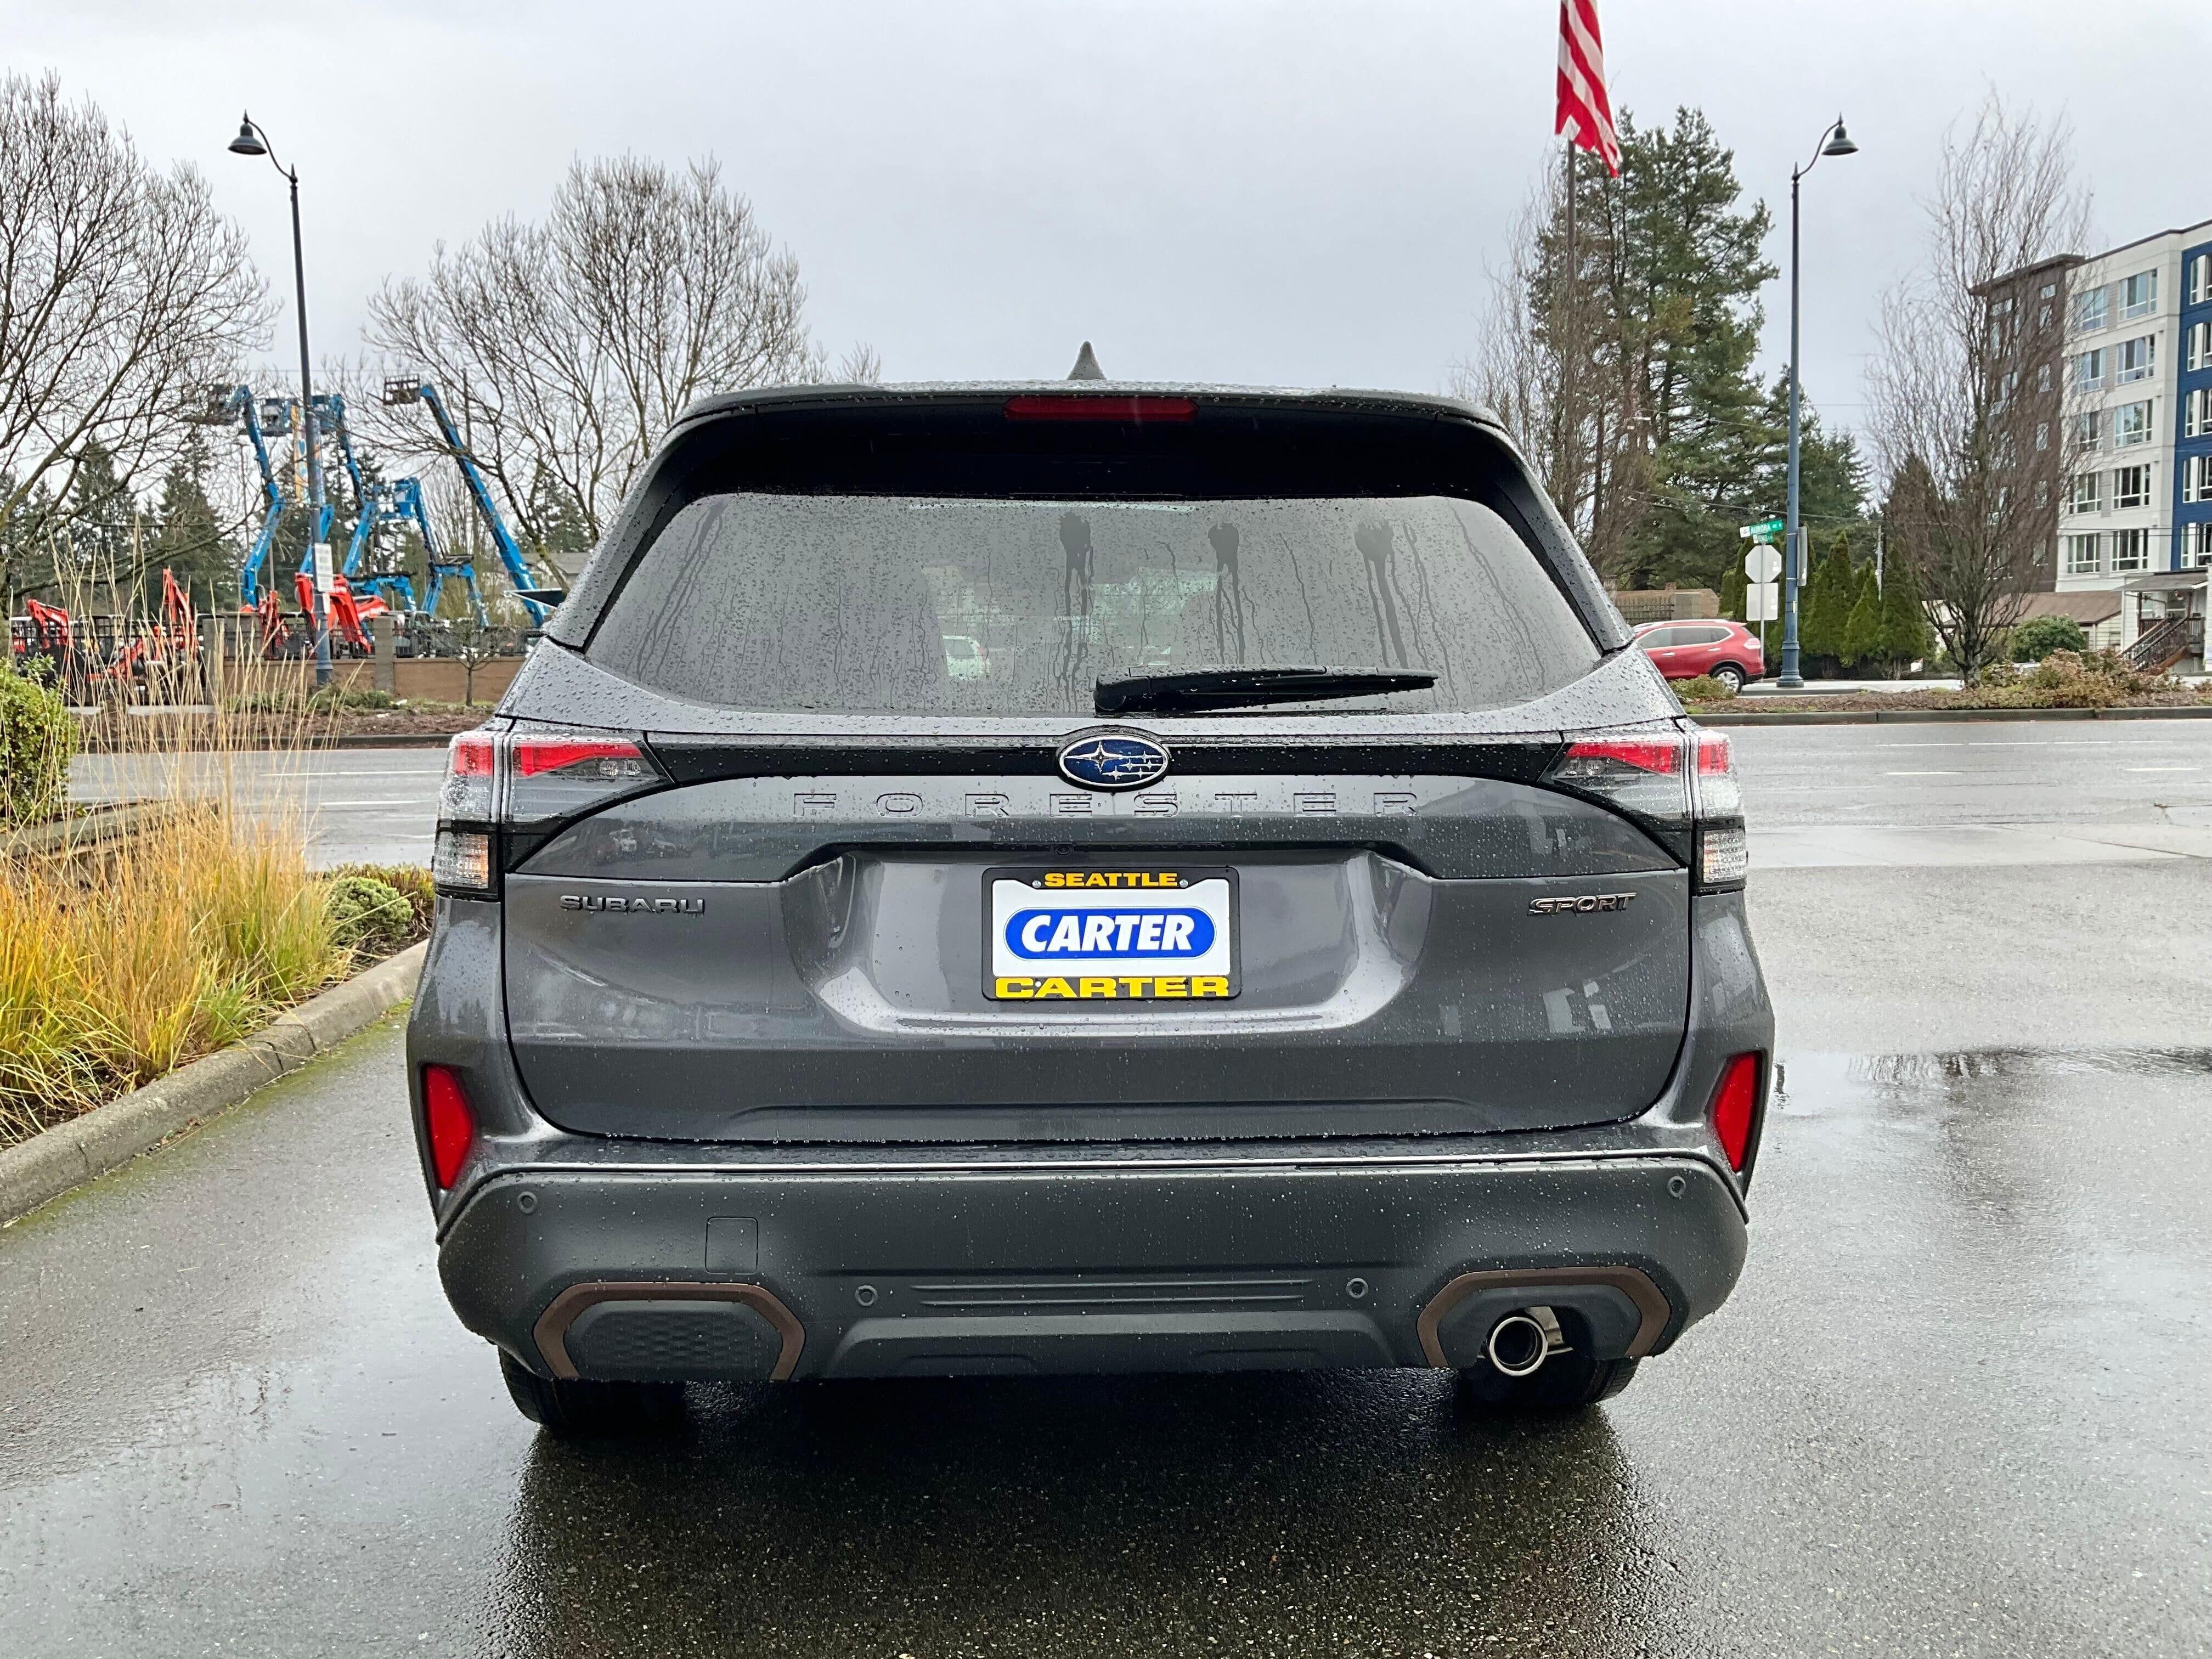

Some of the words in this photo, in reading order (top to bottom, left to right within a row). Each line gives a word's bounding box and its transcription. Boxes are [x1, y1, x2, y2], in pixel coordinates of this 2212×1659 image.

[793, 793, 1418, 817] FORESTER
[1044, 872, 1178, 887] SEATTLE
[560, 895, 704, 913] SUBARU
[1529, 892, 1637, 914] SPORT
[1021, 915, 1195, 952] CARTER
[995, 977, 1229, 998] CARTER
